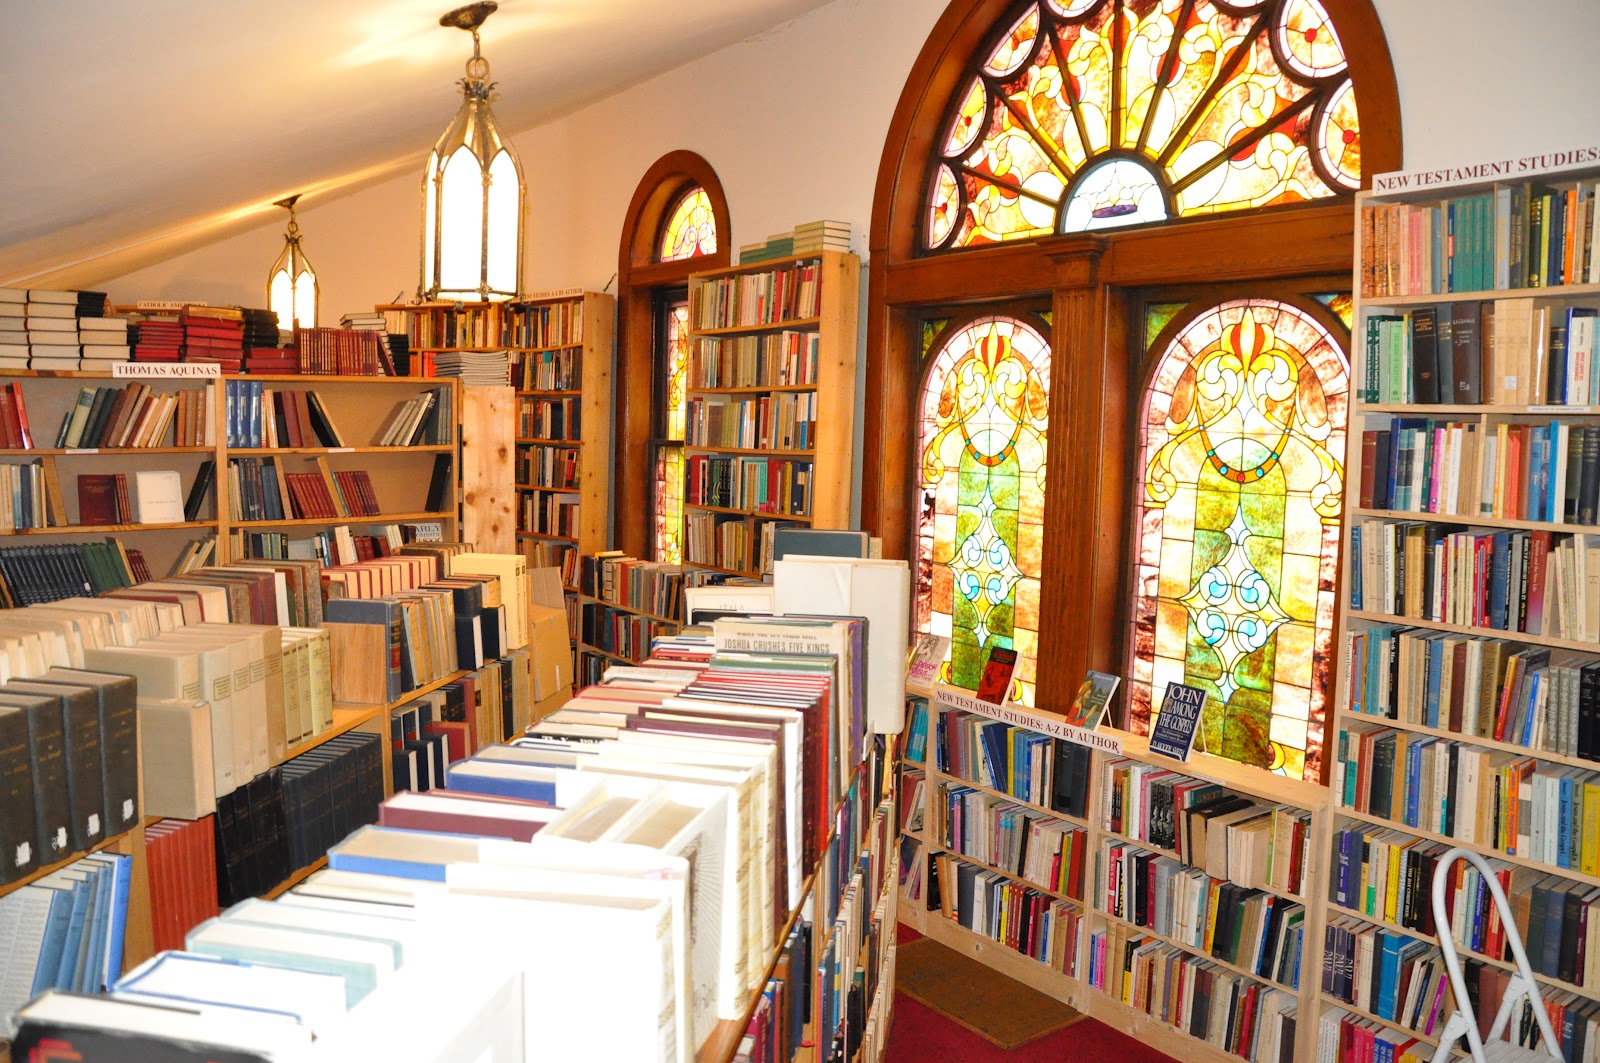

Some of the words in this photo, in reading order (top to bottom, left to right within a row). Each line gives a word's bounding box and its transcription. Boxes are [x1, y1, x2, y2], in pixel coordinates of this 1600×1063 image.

[1376, 176, 1411, 190] NEW
[1414, 162, 1513, 186] TESTAMENT
[117, 366, 166, 374] THOMAS
[170, 366, 218, 376] AQUINAS
[724, 638, 751, 650] JOSHUA
[753, 640, 786, 652] CRUSHES
[789, 642, 804, 653] FIVE
[806, 642, 830, 654] KINGS
[1166, 684, 1203, 705] JOHN
[1172, 701, 1198, 720] AMONG
[936, 690, 953, 704] NEW
[954, 696, 1003, 719] TESTAMENT
[1004, 710, 1043, 730] STUDIES:
[1045, 721, 1061, 735] A-Z
[1062, 726, 1076, 739] BY
[1077, 731, 1120, 754] AUTHOR
[1159, 712, 1172, 727] THE
[1170, 715, 1194, 734] GOSPELS
[1324, 950, 1333, 972] PAUL
[1335, 953, 1344, 975] PAUL
[1344, 958, 1353, 979] PAUL
